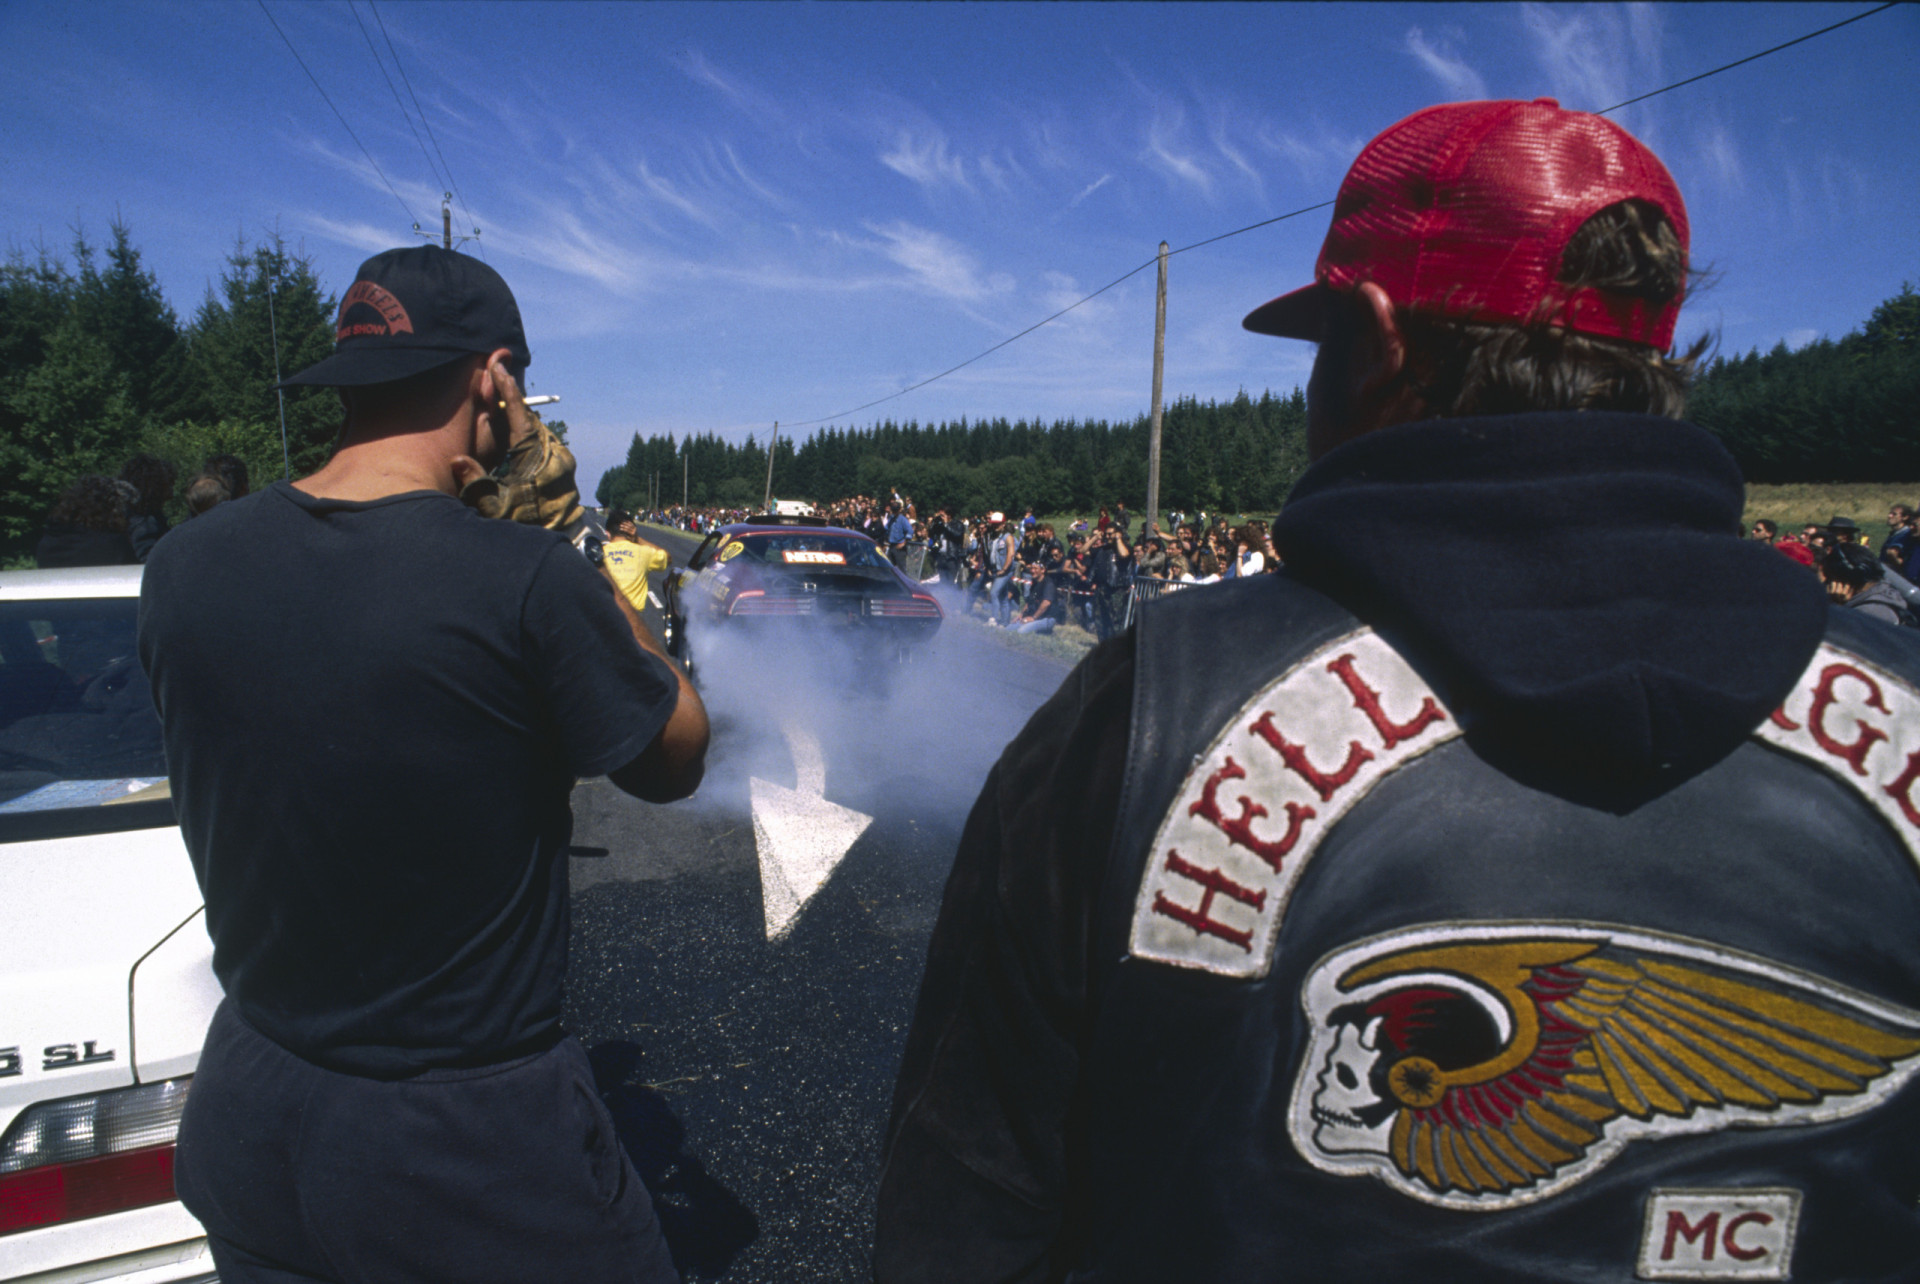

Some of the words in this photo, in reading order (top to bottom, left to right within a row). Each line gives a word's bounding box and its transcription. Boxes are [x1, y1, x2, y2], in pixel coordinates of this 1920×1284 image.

[353, 324, 387, 335] SHOW
[785, 551, 844, 563] NITRO
[1152, 653, 1446, 953] HELL
[42, 1040, 116, 1071] SL
[1660, 1210, 1774, 1261] MC
